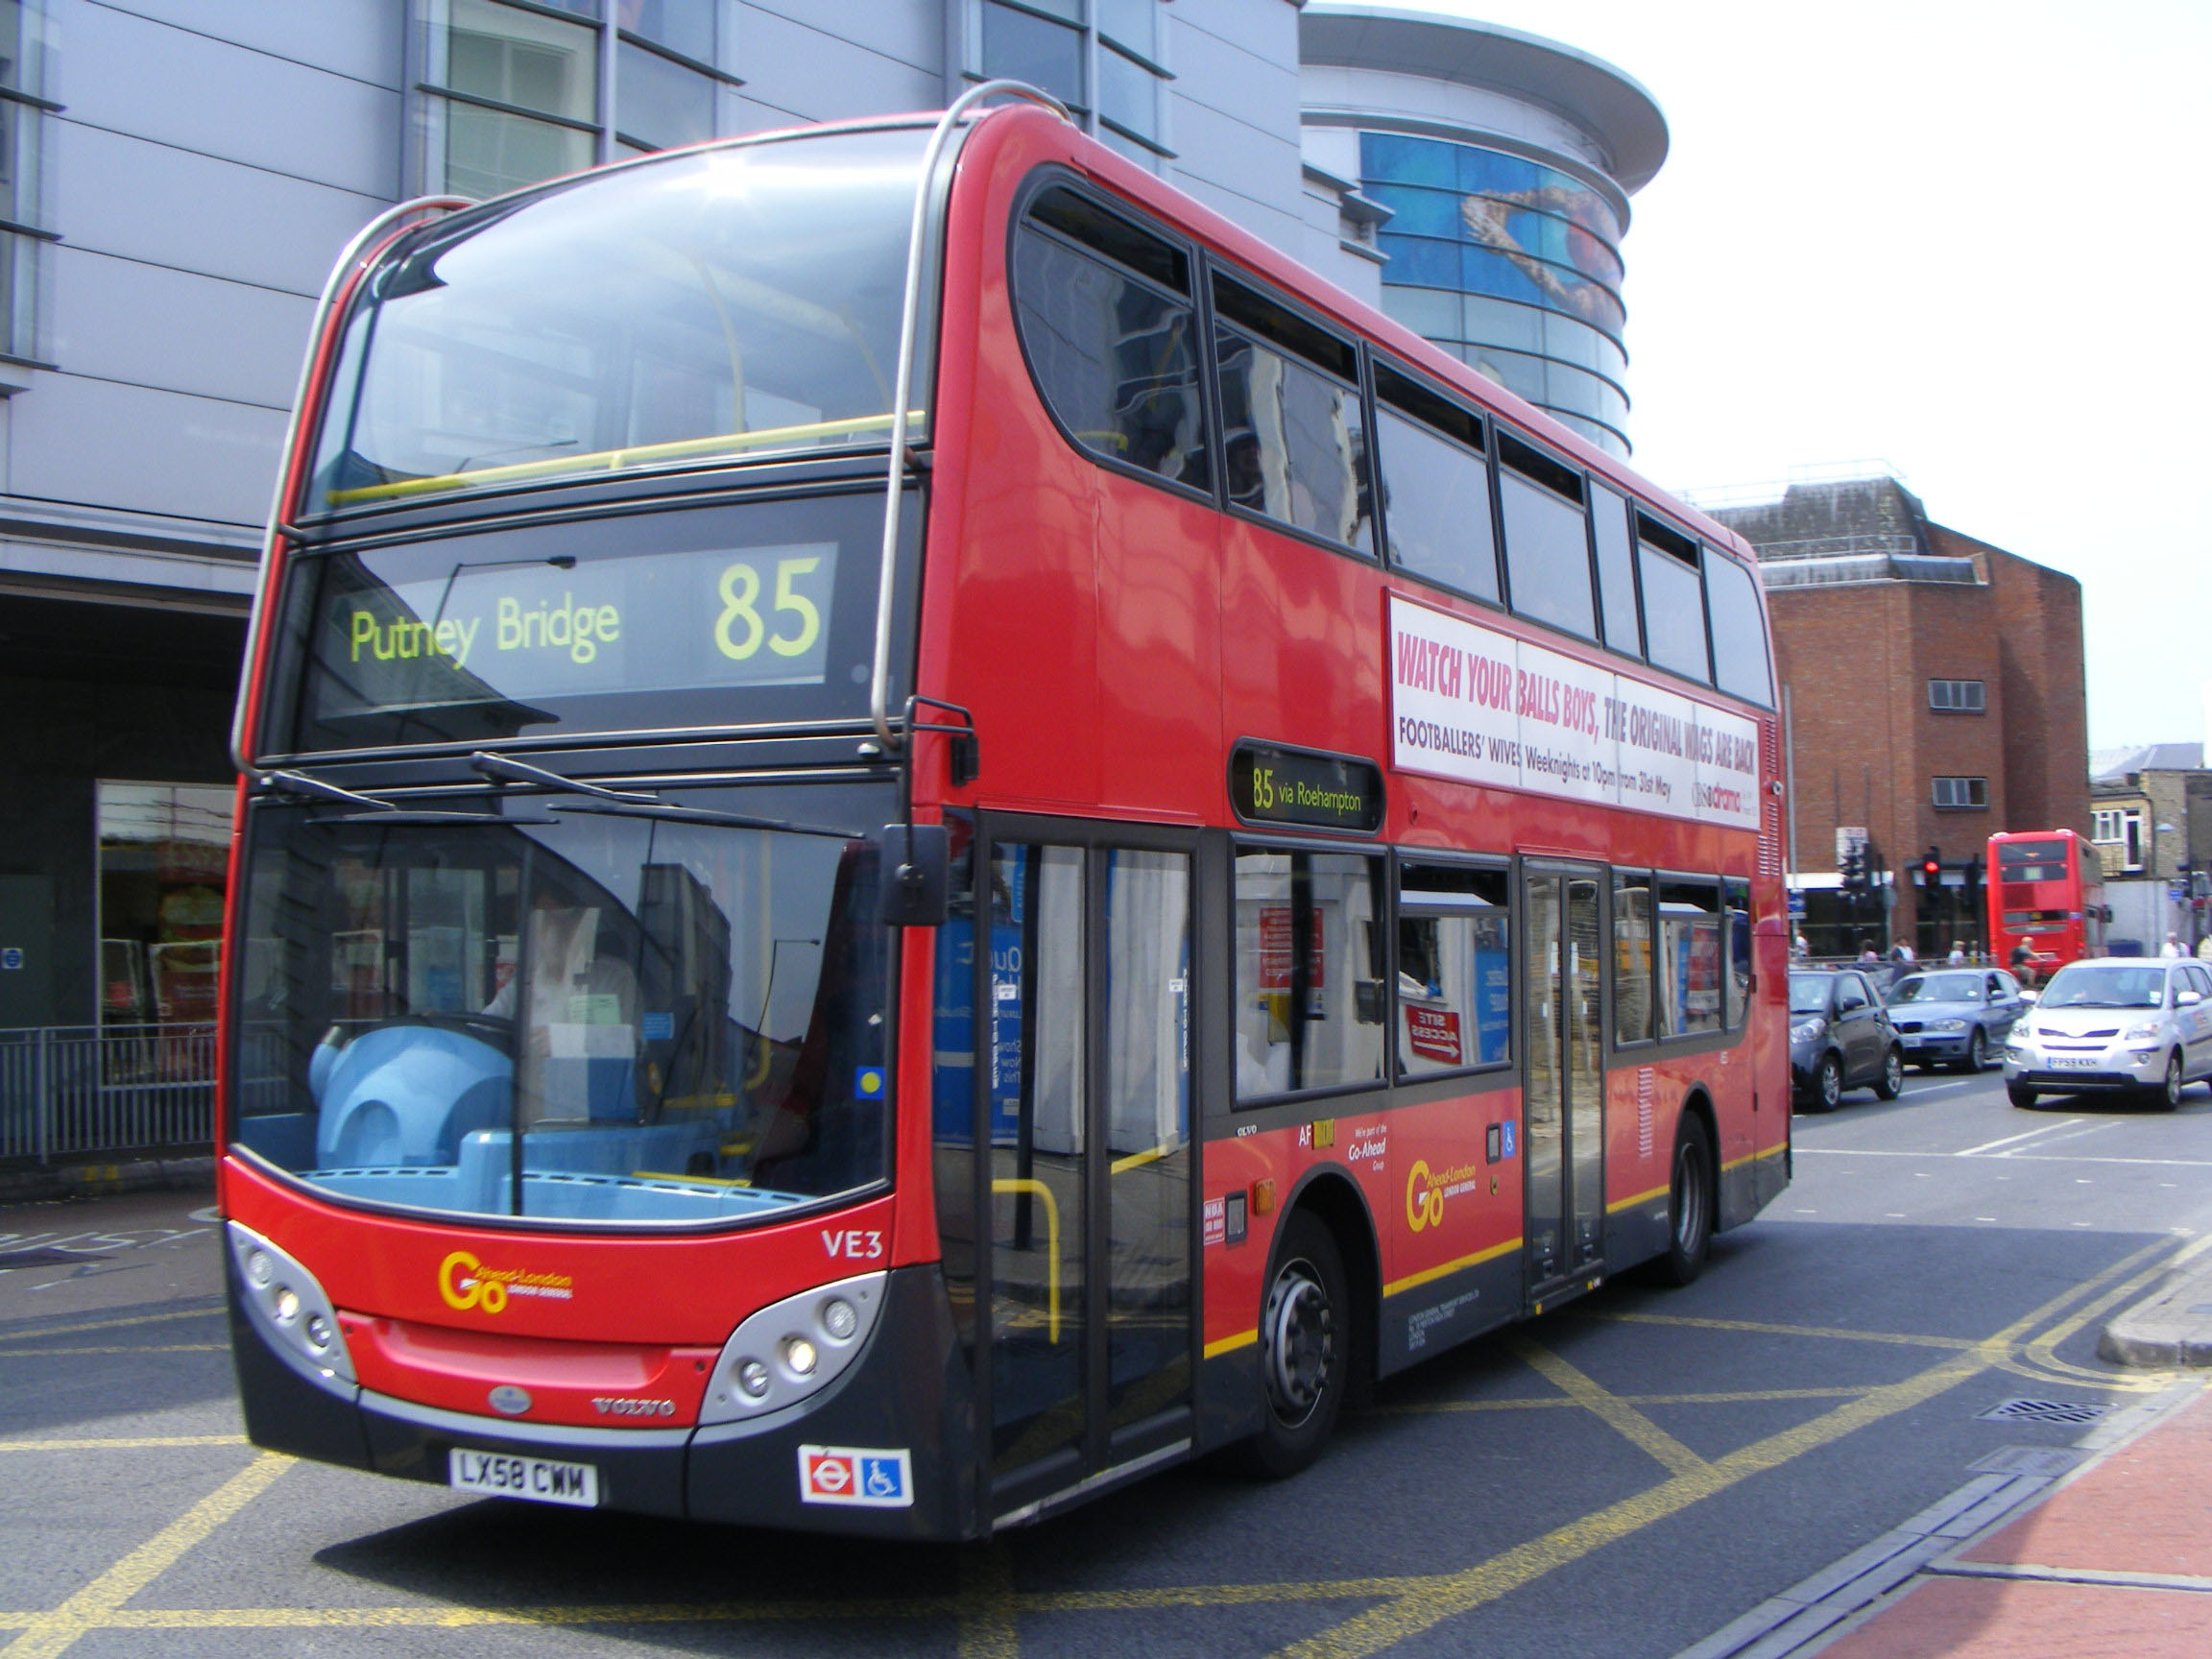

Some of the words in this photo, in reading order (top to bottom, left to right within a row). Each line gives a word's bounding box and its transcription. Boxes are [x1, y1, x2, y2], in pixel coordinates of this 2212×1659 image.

[350, 610, 480, 671] Putney
[496, 592, 621, 664] Bridge
[713, 556, 823, 661] 85
[1398, 631, 1462, 699] WATCH
[1467, 653, 1512, 712] YOUR
[1516, 669, 1559, 725] BALLS
[1562, 683, 1599, 745] BOYS,
[1604, 696, 1627, 743] THE
[1630, 704, 1683, 757] ORIGINAL
[1715, 730, 1732, 770] ARE
[1734, 736, 1755, 776] BACK
[1253, 767, 1274, 809] 85
[1278, 782, 1294, 805] via
[1297, 781, 1361, 816] Roehampton
[1488, 736, 1522, 768] WIVES
[1525, 744, 1580, 784] Weeknights
[1582, 762, 1591, 781] at
[1592, 760, 1615, 792] 10pm
[1638, 770, 1653, 794] 31st
[1655, 775, 1671, 804] May
[1298, 1124, 1311, 1147] AF
[1348, 1136, 1386, 1161] Go-Ahead
[1406, 1160, 1444, 1234] Go
[821, 1229, 883, 1260] VE3
[438, 1251, 508, 1314] Go
[589, 1397, 677, 1417] VOLVO
[458, 1451, 527, 1490] LX58
